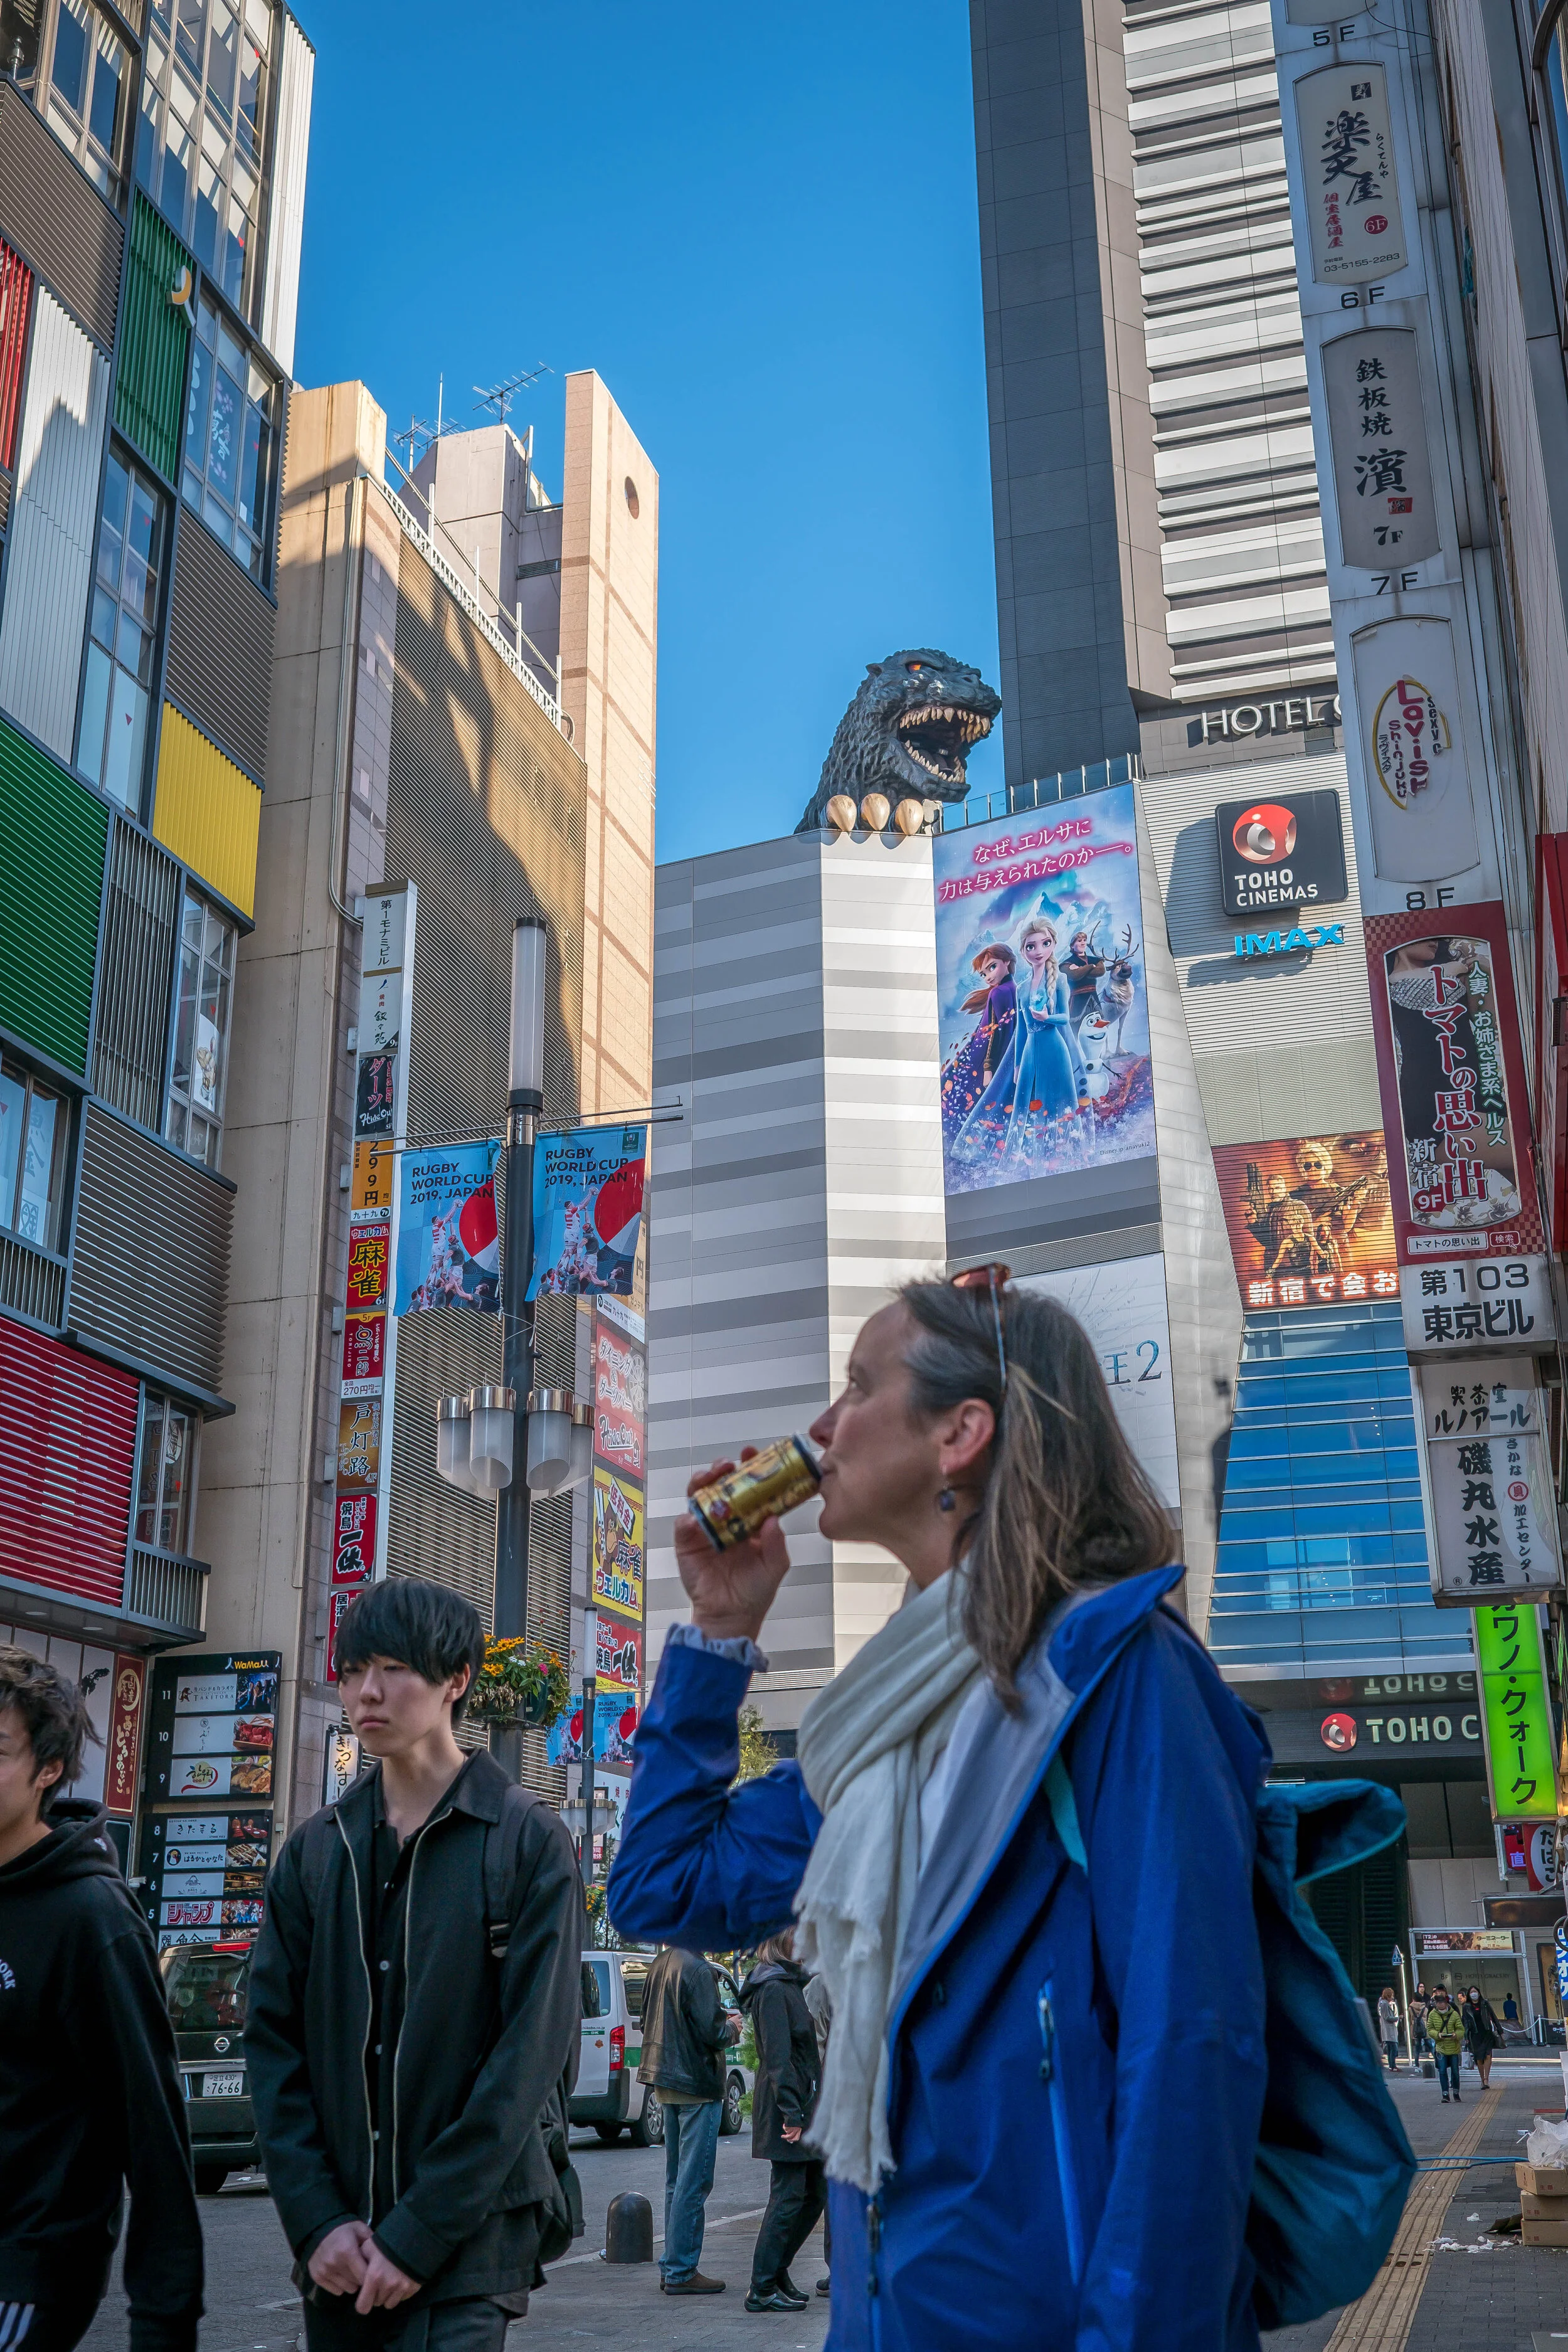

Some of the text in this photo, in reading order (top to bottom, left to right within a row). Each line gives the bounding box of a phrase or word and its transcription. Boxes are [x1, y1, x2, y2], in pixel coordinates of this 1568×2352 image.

[1320, 109, 1384, 206] 楽天屋
[1375, 131, 1389, 179] らくてんや
[1324, 191, 1344, 249] 個室居酒屋
[1365, 218, 1387, 233] 6F
[1323, 252, 1401, 273] 03-5155-2283
[1355, 358, 1394, 438] 鉄板焼
[1373, 525, 1404, 546] 7F
[1201, 695, 1325, 739] HOTEL
[974, 819, 1091, 864] なぜ、エルサに
[1234, 869, 1293, 891] TOHO
[1236, 884, 1318, 907] CINEMAS
[377, 899, 392, 967] 第1モナミビル
[1234, 923, 1345, 956] IMAX
[1468, 960, 1507, 1147] 人妻・お姉さま系ヘルス
[368, 1057, 386, 1110] ダーツ
[1422, 963, 1488, 1204] トマトの思い出
[544, 1157, 629, 1175] WORLD CUP
[545, 1147, 595, 1162] RUGBY
[1409, 1137, 1439, 1189] 新宿
[411, 1162, 460, 1178] RUGBY
[411, 1173, 494, 1191] WORLD CUP
[544, 1171, 628, 1189] 2019, JAPAN
[410, 1187, 494, 1205] 2019, JAPAN
[1417, 1192, 1443, 1210] 9F
[352, 1209, 378, 1220] 九十九
[351, 1224, 389, 1239] ウェルカム
[1414, 1236, 1481, 1249] トマトの思い出
[1495, 1234, 1515, 1244] 検索
[349, 1239, 387, 1298] 麻雀
[1420, 1262, 1530, 1297] 第103
[375, 1295, 386, 1305] 6F
[1248, 1270, 1397, 1305] 新宿で会お
[362, 1313, 371, 1322] 5F
[1421, 1298, 1535, 1344] 東京ビル
[1450, 1382, 1508, 1407] 喫茶室
[1434, 1403, 1531, 1435] ルノアール
[348, 1404, 371, 1476] 戸灯路
[1505, 1438, 1522, 1476] さかな
[339, 1501, 354, 1531] 焼鳥
[610, 1481, 633, 1530] 低料金
[1456, 1441, 1506, 1587] 磯丸水産
[336, 1528, 364, 1575] 一休
[1513, 1503, 1532, 1584] 加工センター
[615, 1538, 644, 1581] 麻雀
[595, 1567, 640, 1611] ウェルカム
[334, 1592, 349, 1628] 居酒
[612, 1640, 638, 1685] 一休
[162, 1690, 171, 1700] 11
[158, 1731, 169, 1742] 10
[1365, 1714, 1453, 1744] TOHO
[159, 1773, 166, 1783] 9
[154, 1825, 161, 1836] 8
[152, 1852, 159, 1863] 7
[150, 1880, 156, 1891] 6
[147, 1909, 155, 1919] 5
[0, 1959, 16, 1989] ORK
[211, 2082, 240, 2094] 76-66
